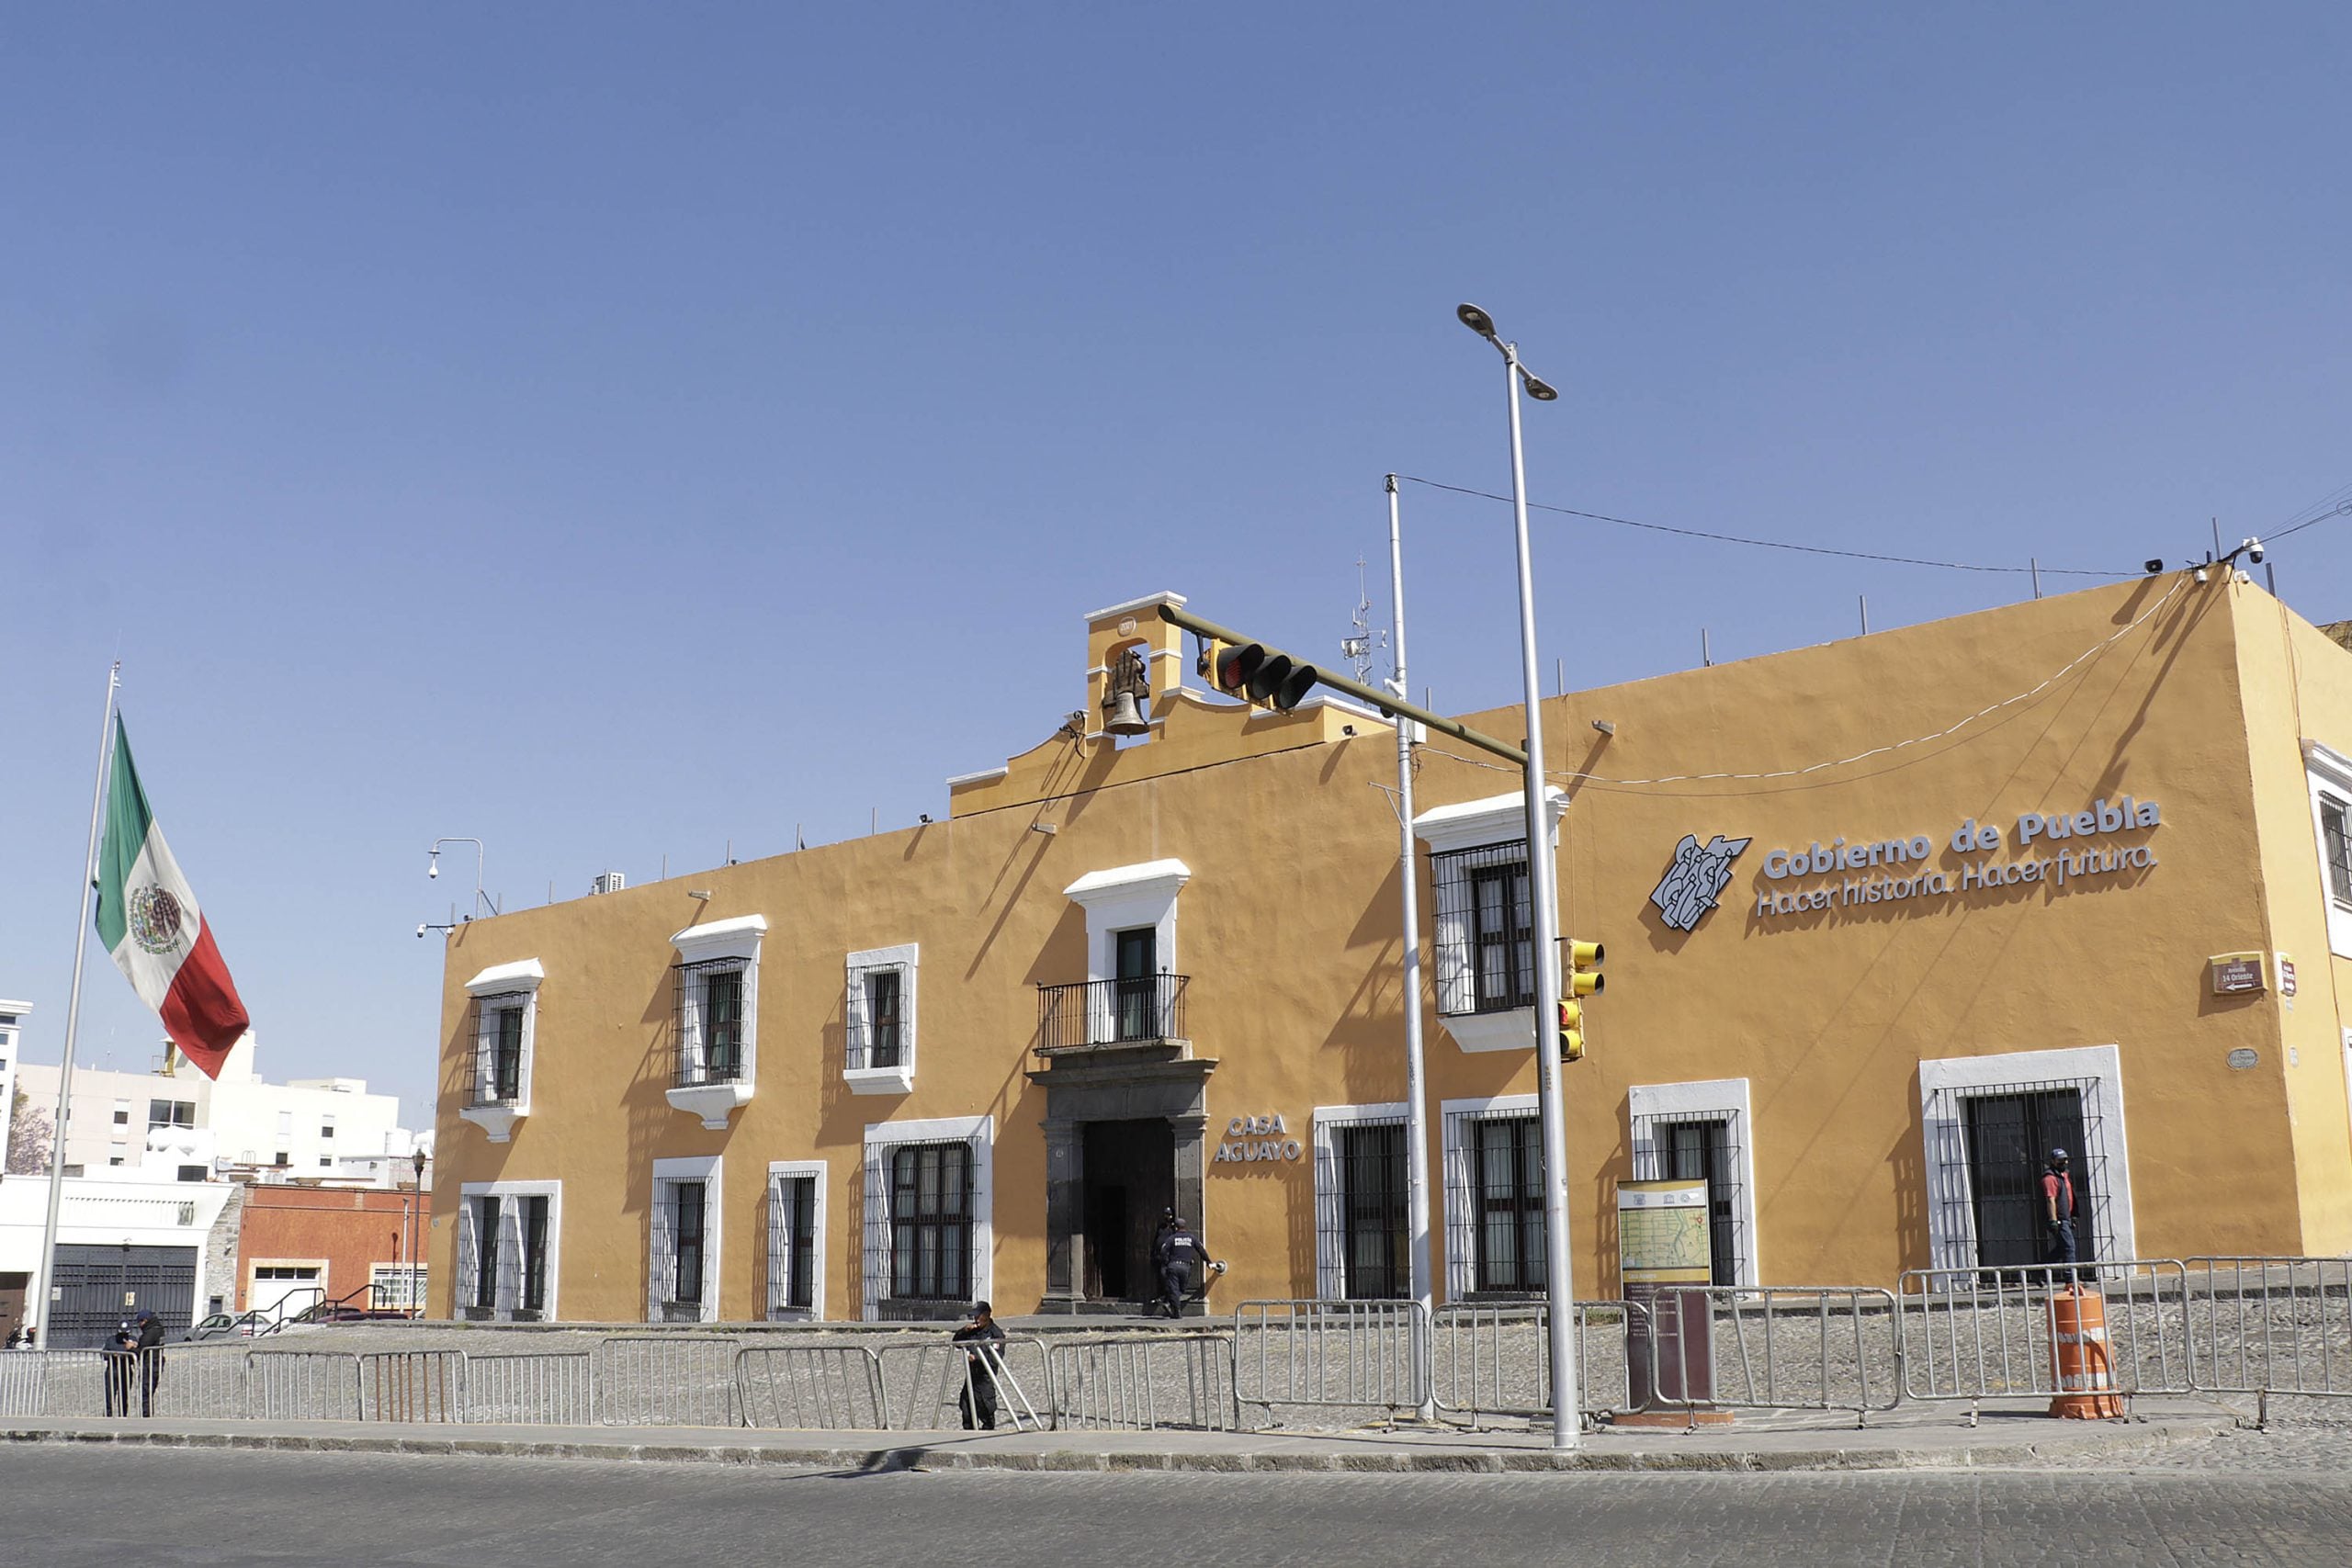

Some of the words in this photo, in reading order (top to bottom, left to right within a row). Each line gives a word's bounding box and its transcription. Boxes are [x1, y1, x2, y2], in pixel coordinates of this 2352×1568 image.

[1763, 836, 1931, 880] Gobierno
[1951, 818, 2001, 853] de
[2018, 795, 2161, 846] Puebla
[1757, 887, 1838, 918] Hacer
[1841, 868, 1955, 907] historia.
[1962, 857, 2054, 891] Hacer
[2055, 846, 2159, 886] futuro.
[1228, 1113, 1286, 1137] CASA
[1214, 1139, 1301, 1163] AGUAYO
